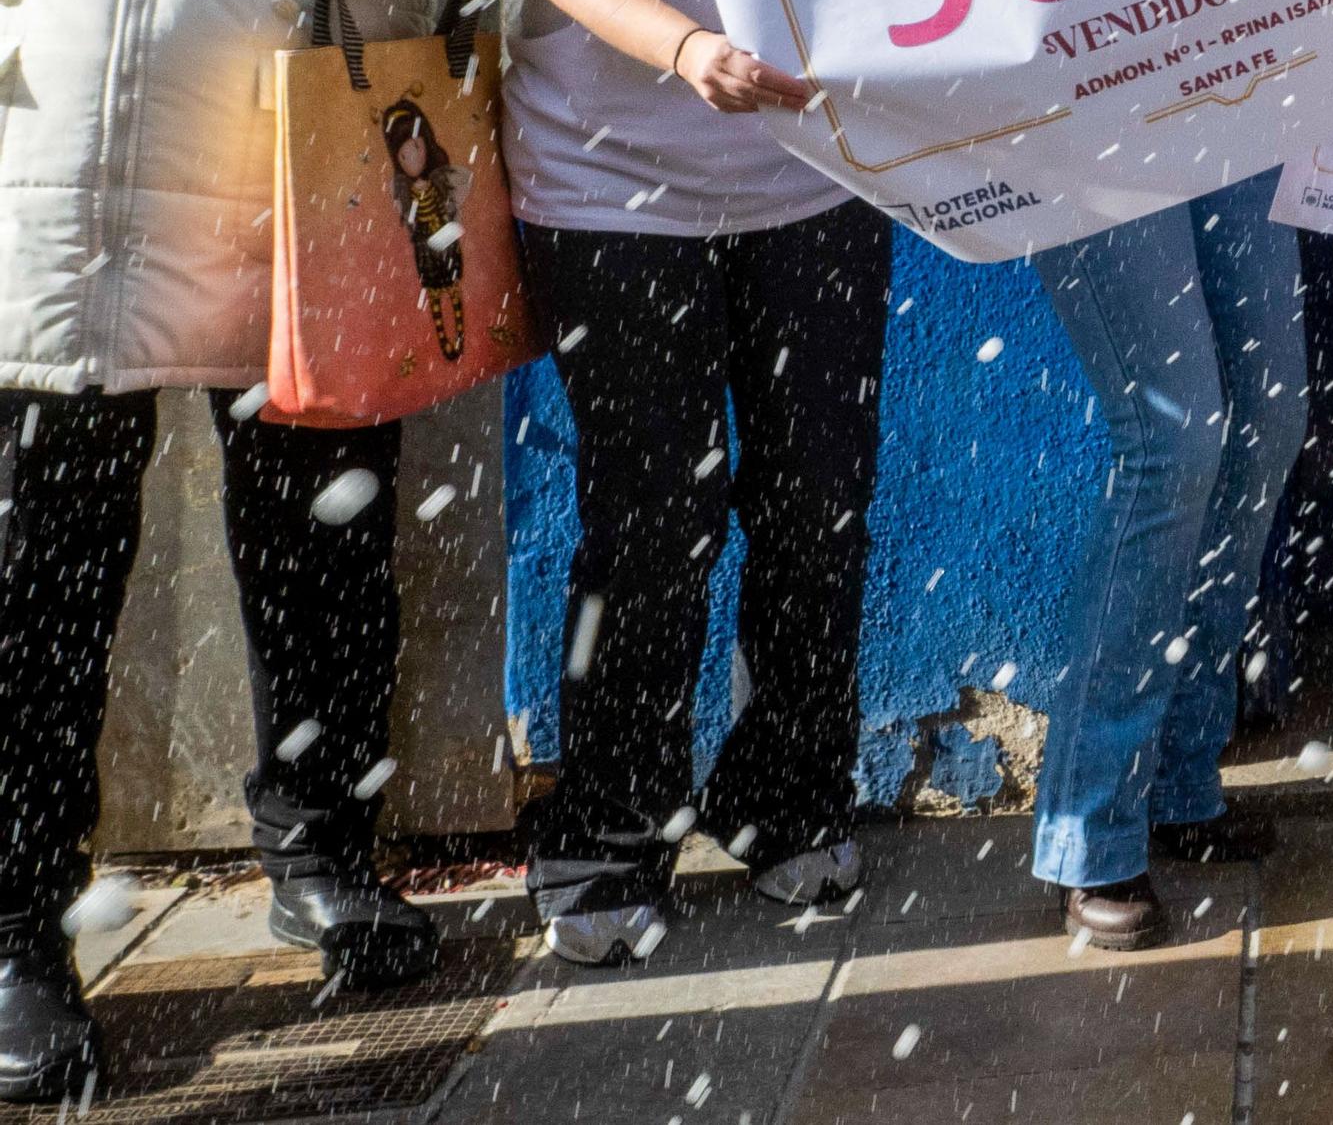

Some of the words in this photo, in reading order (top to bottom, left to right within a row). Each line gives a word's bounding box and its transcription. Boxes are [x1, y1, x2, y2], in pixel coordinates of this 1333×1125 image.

[1074, 57, 1162, 101] ADMON.
[1221, 15, 1285, 47] REINA
[1179, 60, 1250, 96] SANTA
[1252, 48, 1278, 69] FE
[923, 181, 1013, 218] LOTERÍA
[930, 191, 1042, 233] NACIONAL
